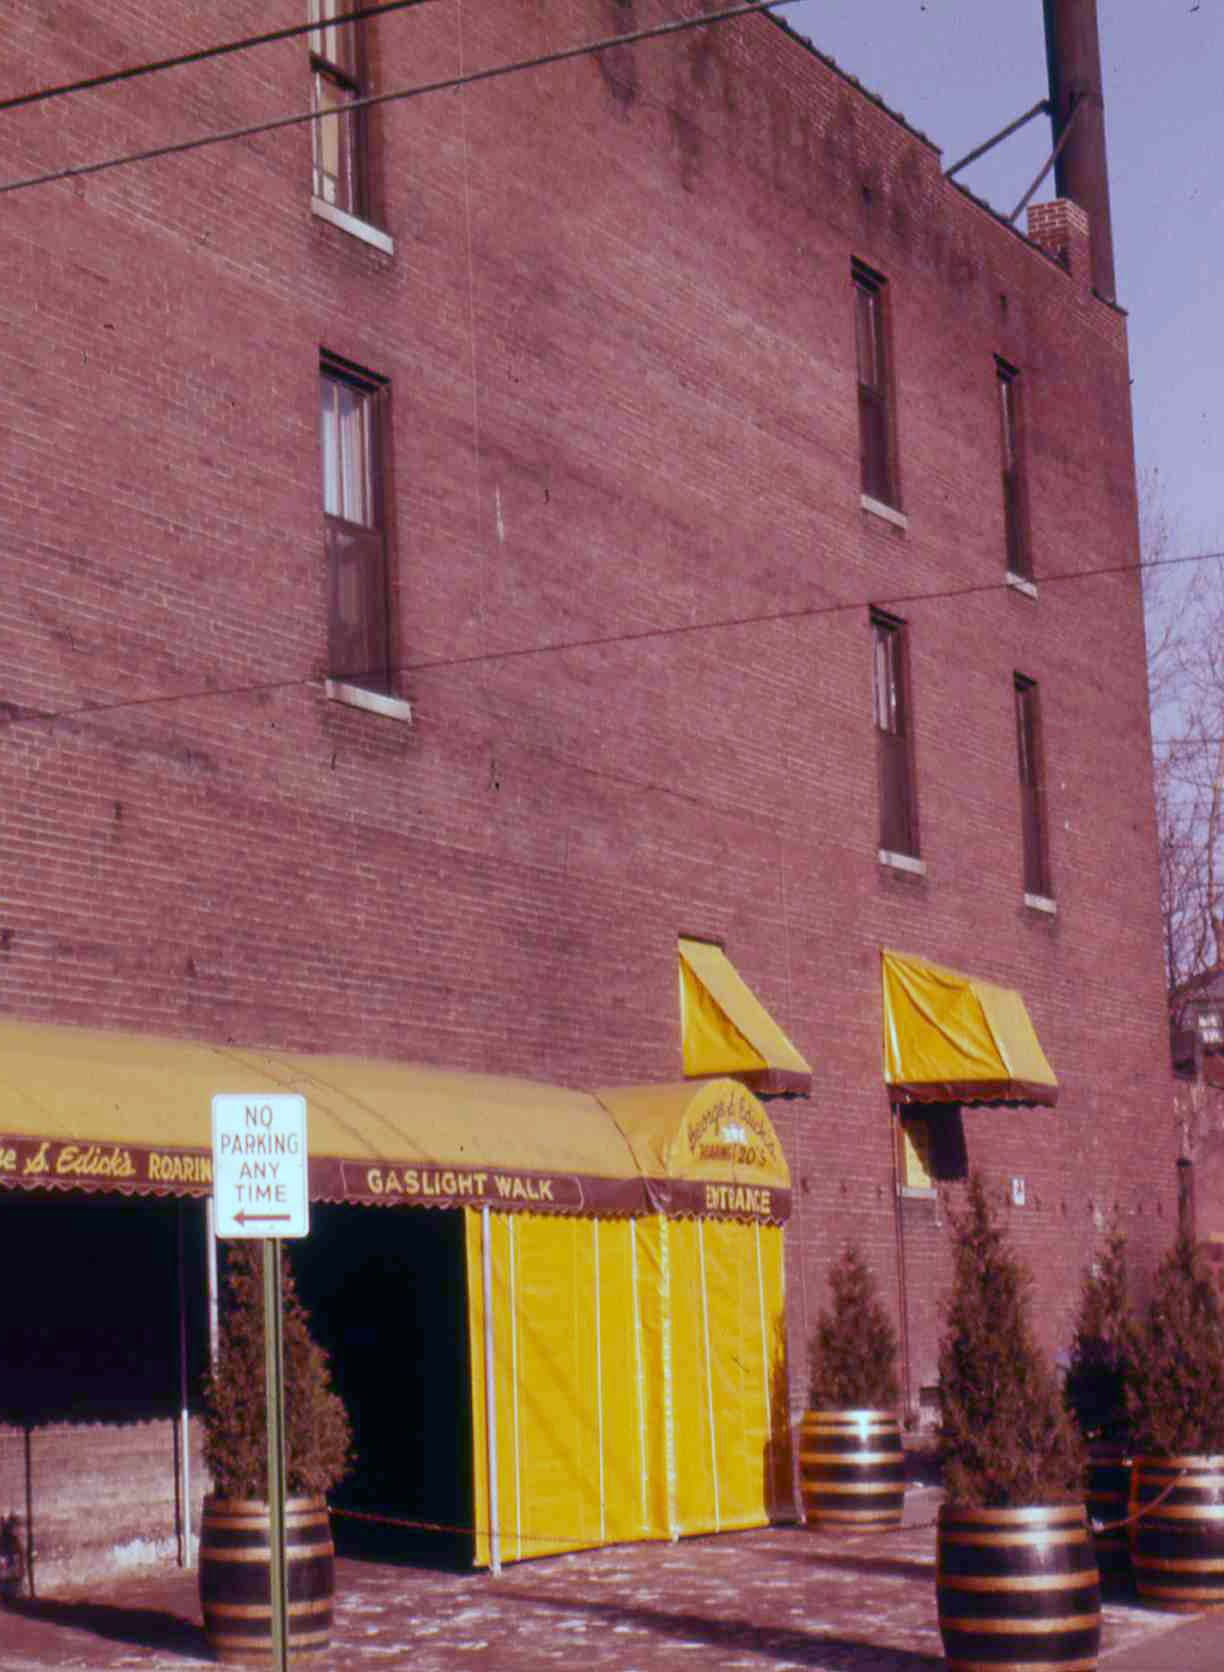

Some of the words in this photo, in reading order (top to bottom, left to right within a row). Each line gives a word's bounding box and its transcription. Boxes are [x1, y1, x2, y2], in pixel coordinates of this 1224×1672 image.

[245, 1104, 273, 1128] NO
[220, 1132, 299, 1154] PARKING
[149, 1152, 212, 1184] ROARIN
[240, 1161, 280, 1179] ANY
[235, 1184, 288, 1202] TIME
[367, 1167, 488, 1196] GASLIGHT
[494, 1174, 553, 1200] WALK
[705, 1183, 772, 1216] ENTRANCE
